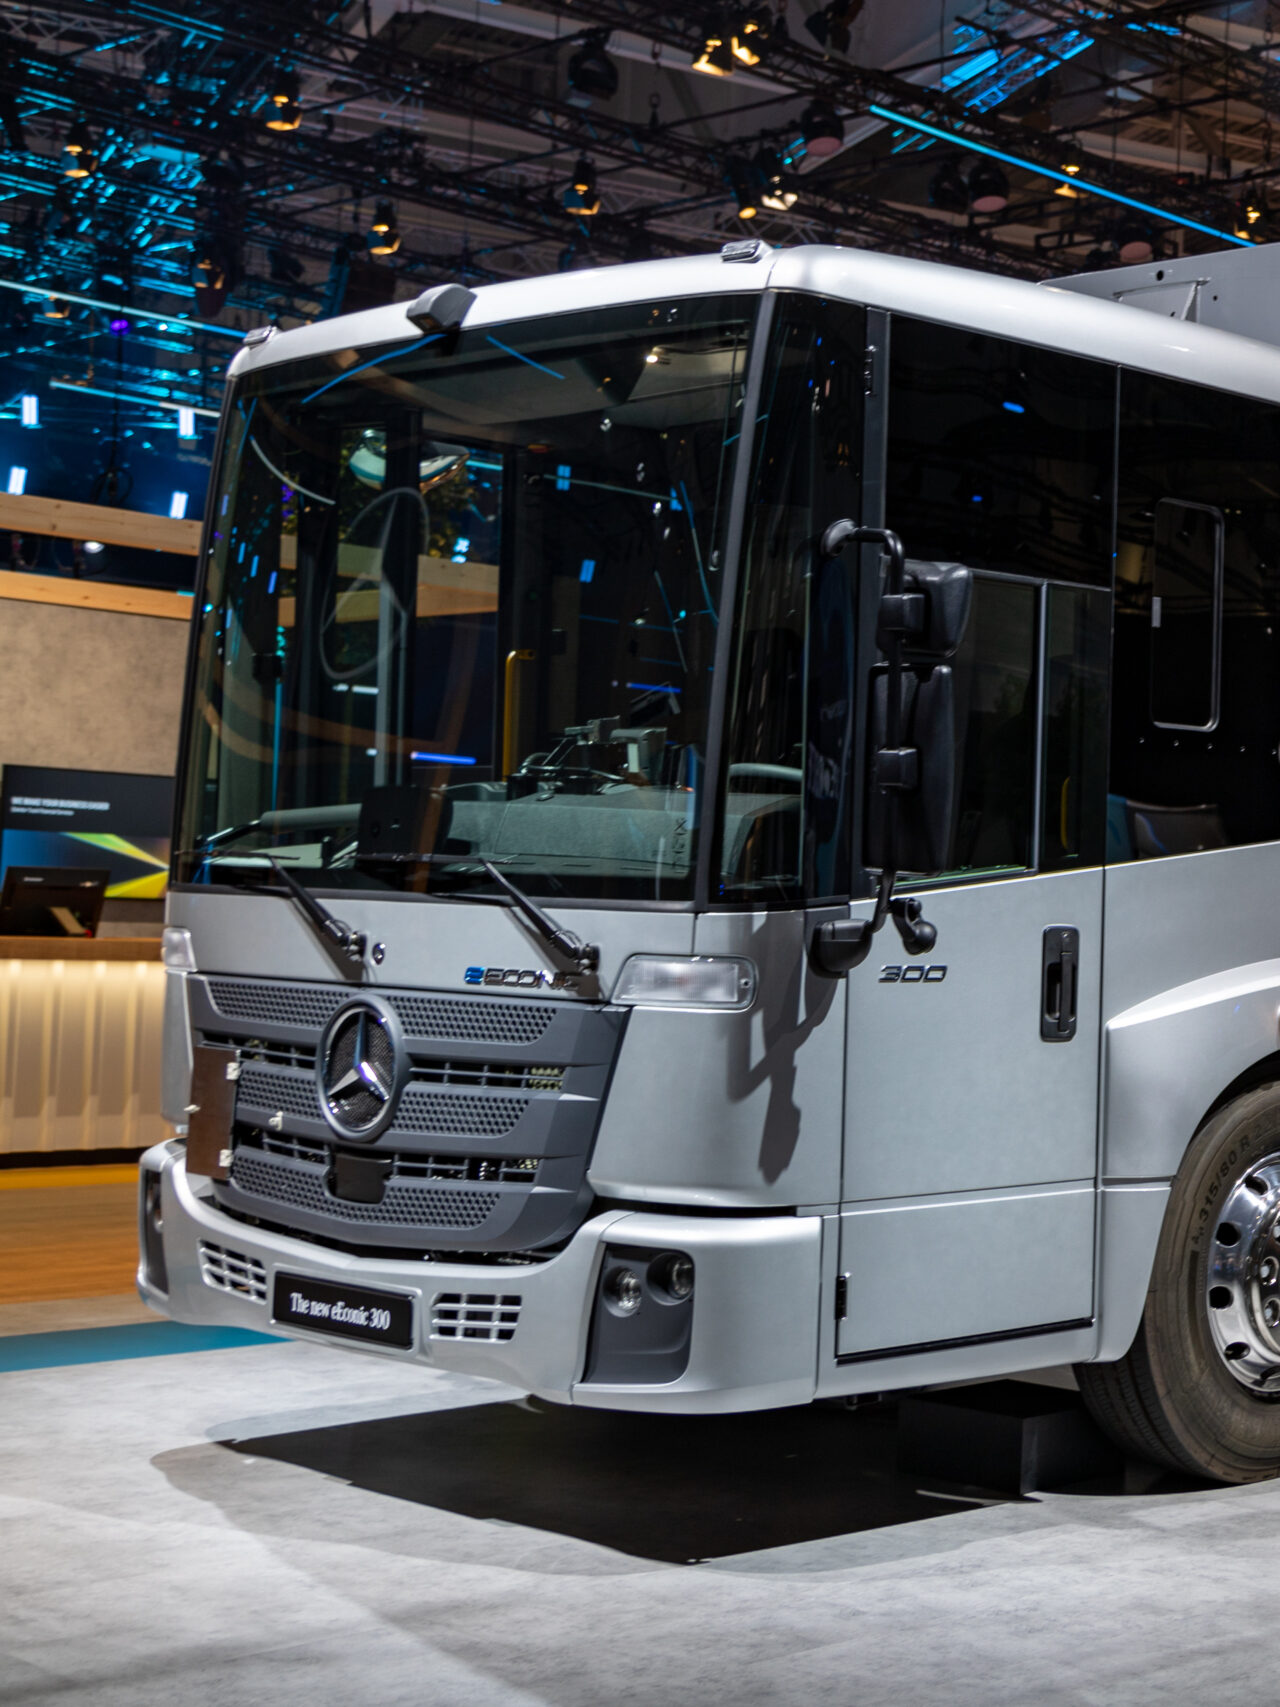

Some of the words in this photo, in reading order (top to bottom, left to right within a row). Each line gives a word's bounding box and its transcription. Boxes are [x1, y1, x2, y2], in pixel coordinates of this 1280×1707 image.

[878, 965, 948, 983] 300
[1198, 1149, 1238, 1223] 315/80
[1238, 1134, 1251, 1152] R
[289, 1292, 310, 1315] The
[310, 1301, 331, 1318] new
[331, 1301, 369, 1327] eEconic
[369, 1308, 392, 1331] 300
